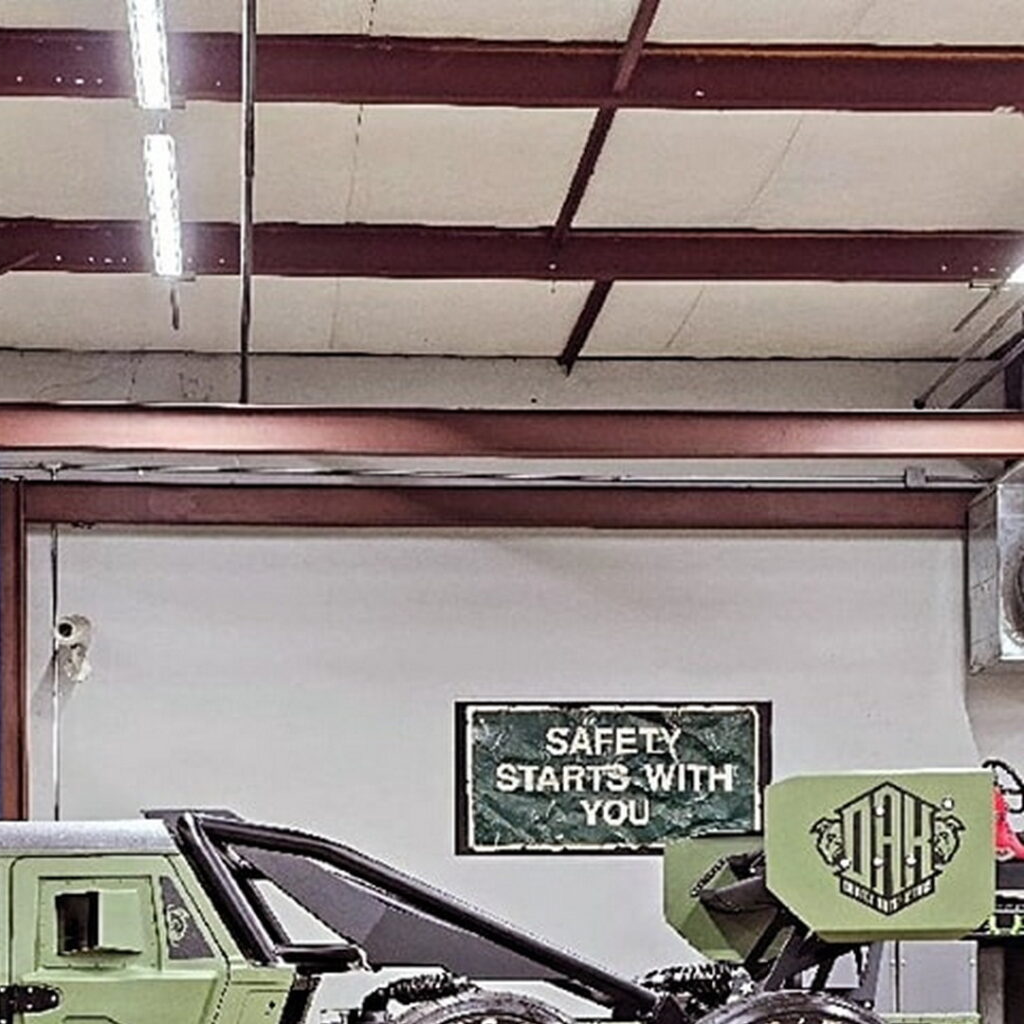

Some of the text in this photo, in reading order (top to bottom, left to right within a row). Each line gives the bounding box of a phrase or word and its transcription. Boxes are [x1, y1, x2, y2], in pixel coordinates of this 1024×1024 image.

[545, 727, 682, 756] SAFETY
[495, 763, 733, 792] STARTS WITH
[580, 798, 650, 826] YOU
